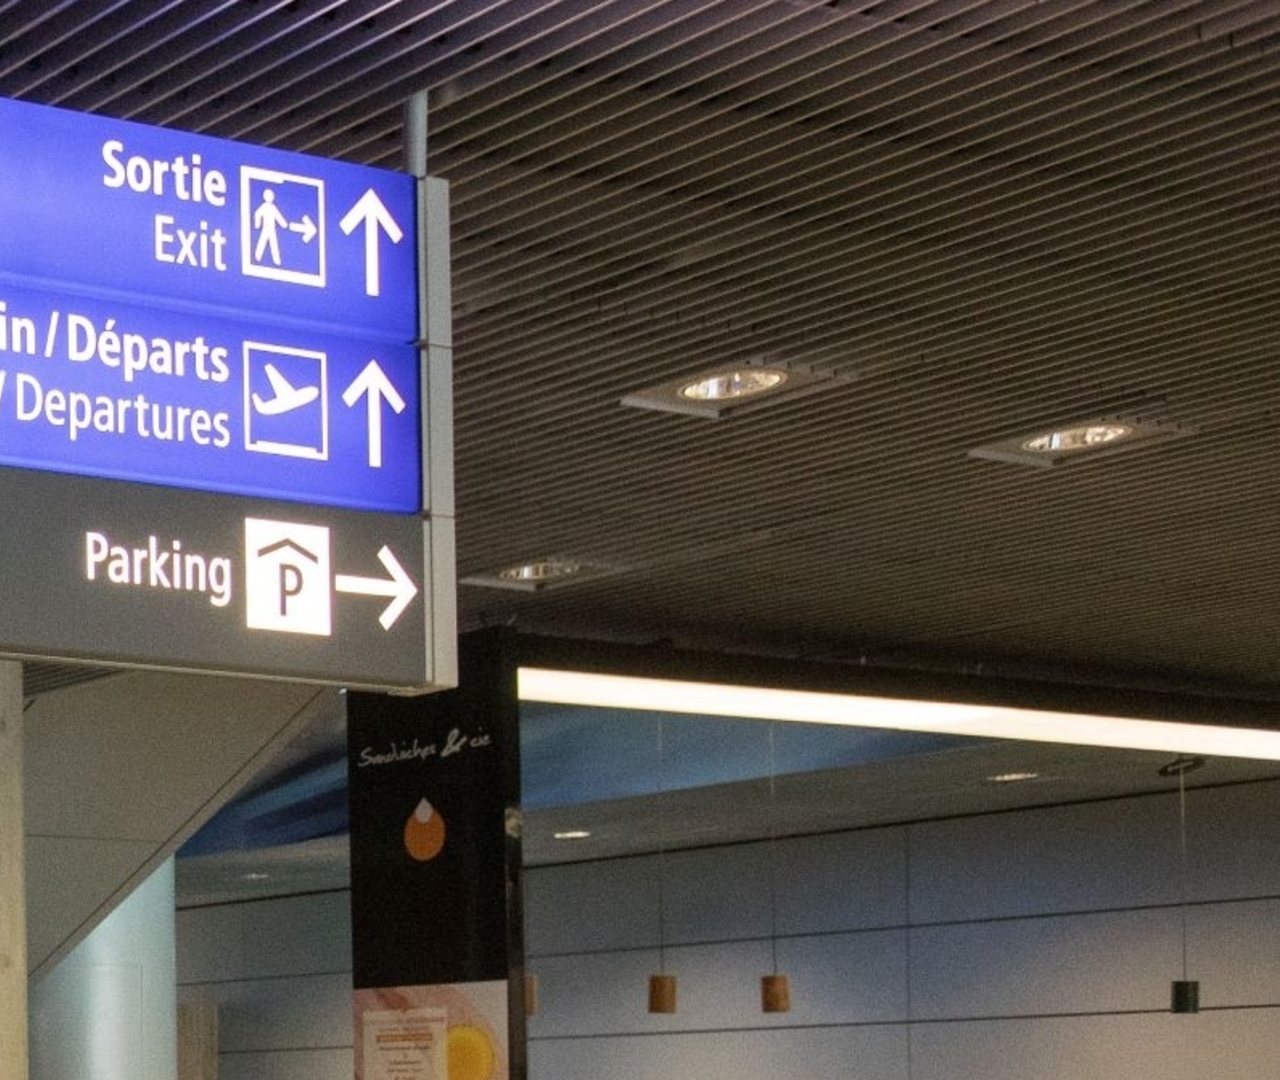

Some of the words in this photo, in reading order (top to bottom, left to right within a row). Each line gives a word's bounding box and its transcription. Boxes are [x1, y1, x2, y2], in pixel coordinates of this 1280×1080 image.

[101, 139, 228, 207] Sortie
[154, 213, 228, 271] Exit
[67, 312, 230, 384] Départs
[15, 372, 231, 449] Departures
[85, 530, 232, 608] Parking
[440, 727, 468, 758] &
